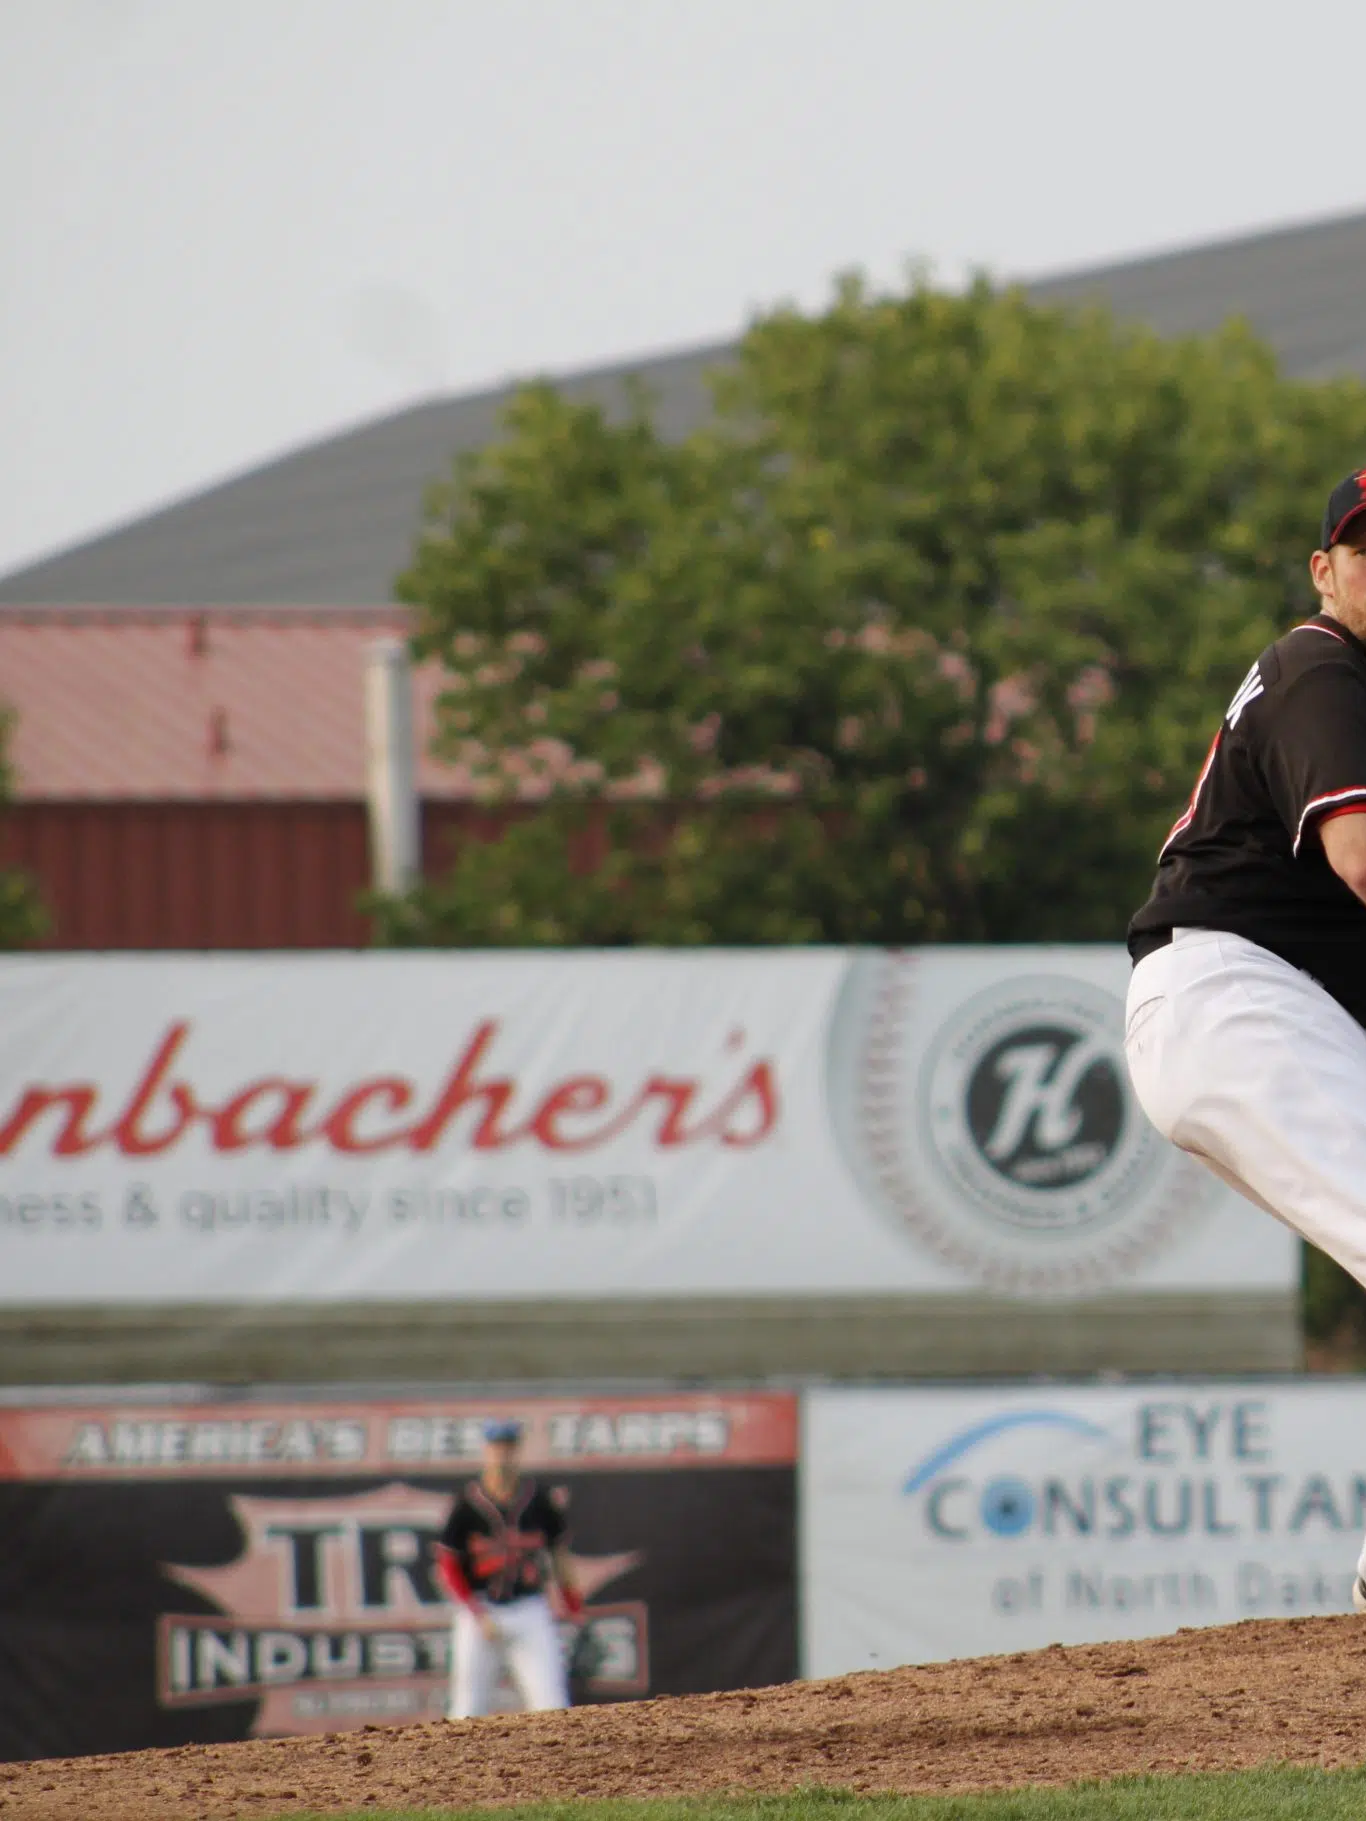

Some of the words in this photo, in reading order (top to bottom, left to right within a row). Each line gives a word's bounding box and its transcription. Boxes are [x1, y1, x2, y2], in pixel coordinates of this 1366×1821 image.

[984, 1035, 1112, 1161] H
[121, 1182, 158, 1228] &
[180, 1182, 368, 1234] quality
[388, 1184, 530, 1228] since
[64, 1417, 366, 1465] AMERICA'S
[388, 1414, 532, 1457] BES
[549, 1411, 730, 1457] TARPS
[1137, 1401, 1271, 1462] EYE
[264, 1516, 456, 1616] TR
[993, 1566, 1044, 1613] of
[1064, 1566, 1218, 1612] North
[1236, 1560, 1357, 1608] Dak
[170, 1615, 640, 1695] INDUSTS
